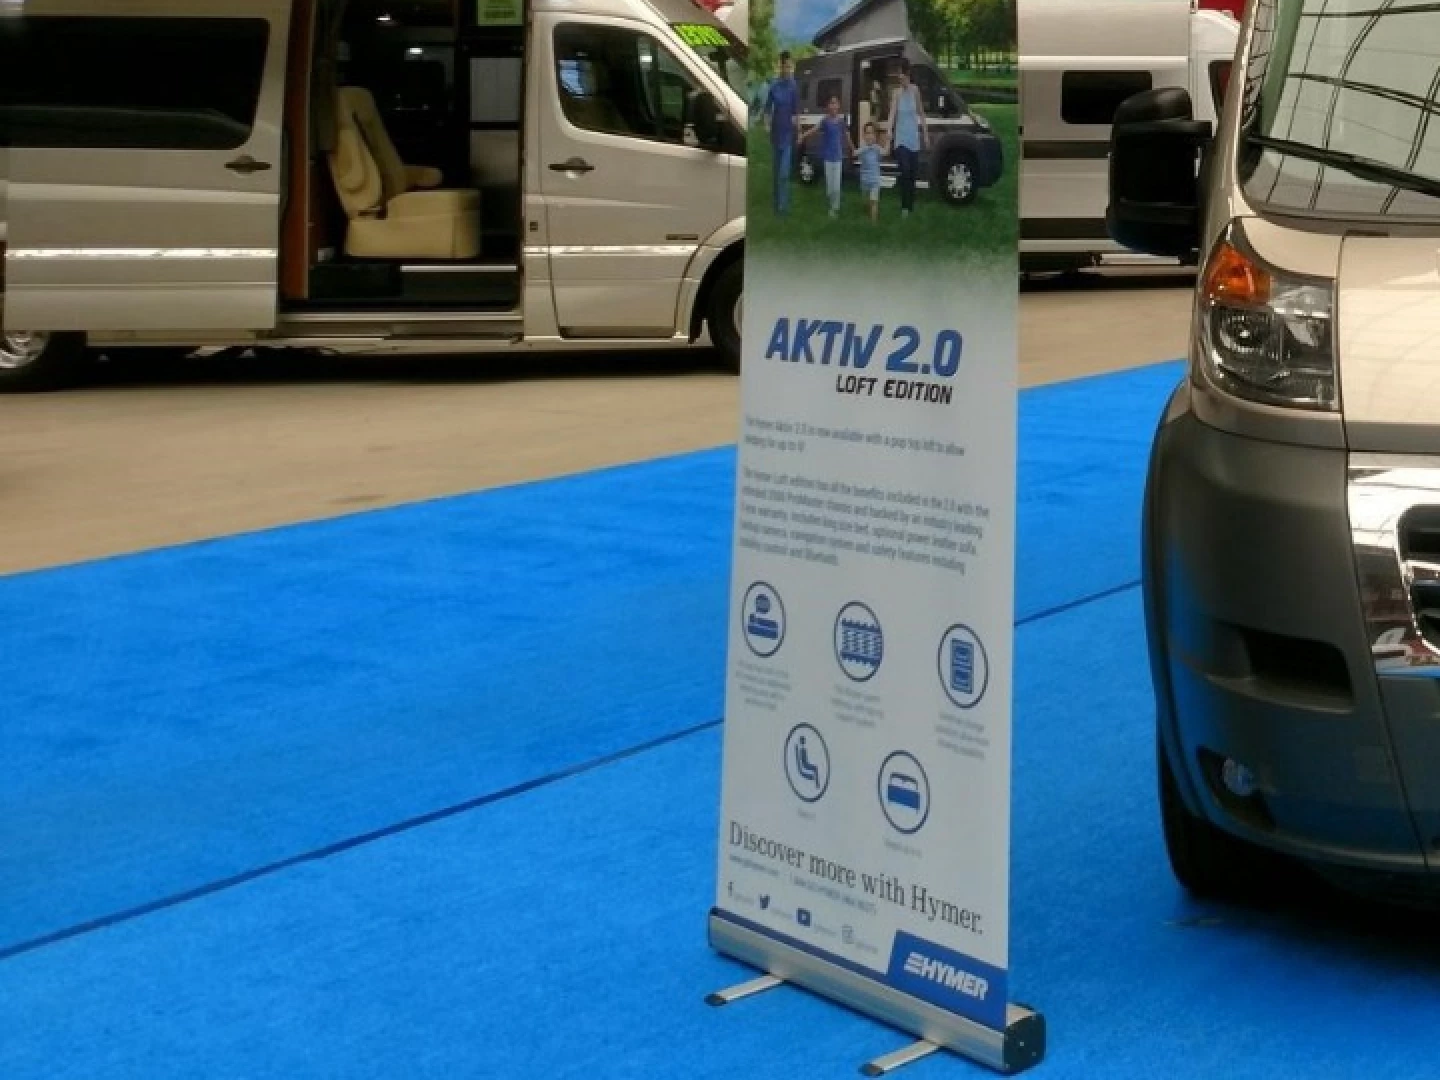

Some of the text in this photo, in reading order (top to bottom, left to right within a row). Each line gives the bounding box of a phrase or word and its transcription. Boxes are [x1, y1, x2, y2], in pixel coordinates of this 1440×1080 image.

[765, 317, 963, 378] AKTIV 2.0
[836, 374, 953, 405] LOFT EDITION
[730, 821, 805, 869] Discover
[809, 853, 857, 889] more
[861, 872, 905, 907] with
[911, 883, 984, 935] Hymer.
[917, 953, 989, 1001] HYMER
